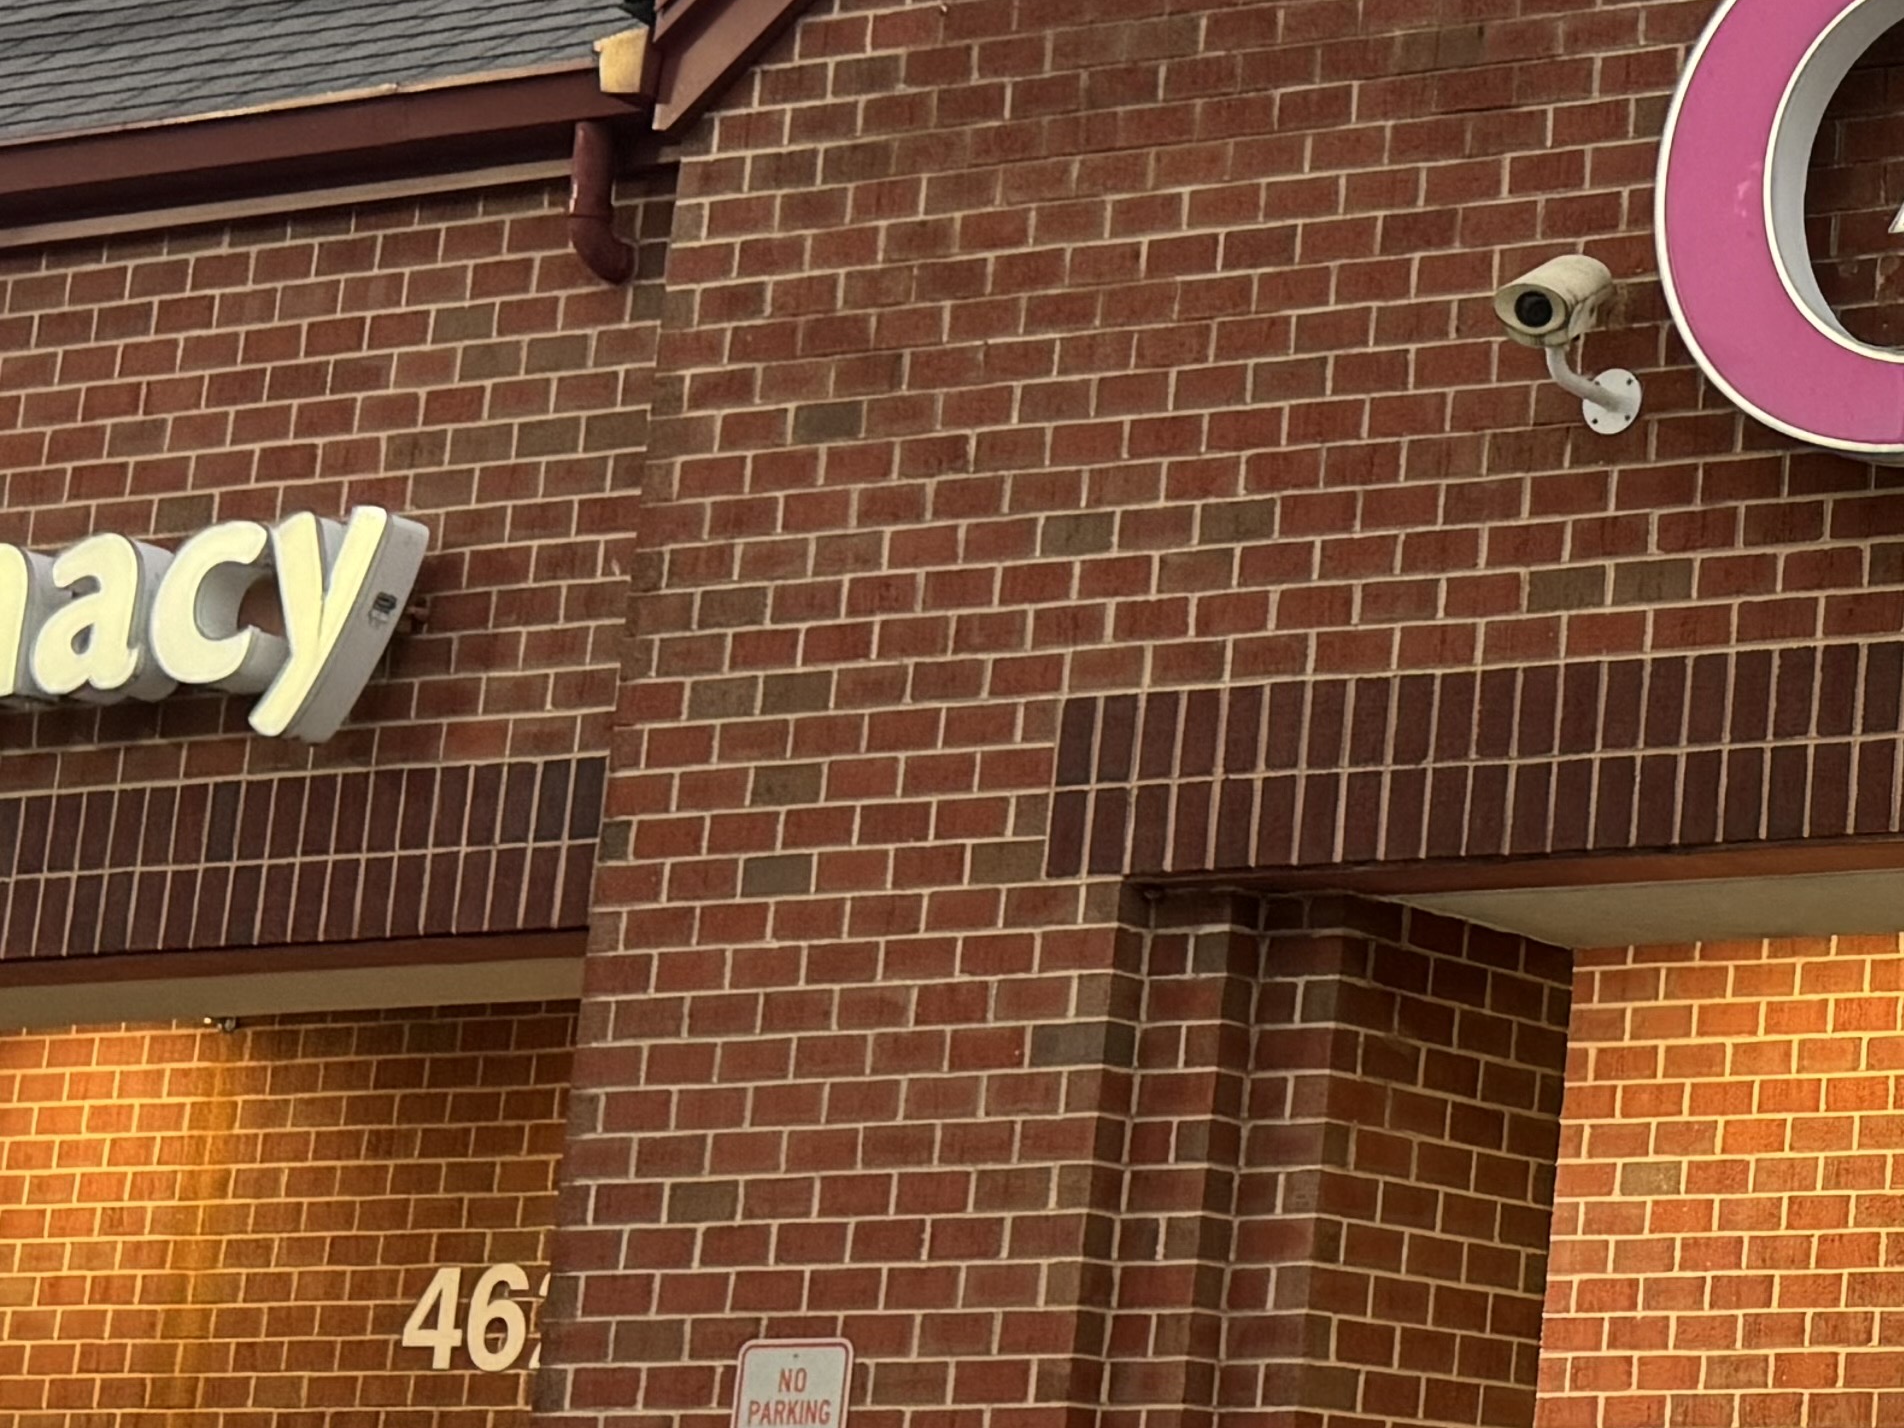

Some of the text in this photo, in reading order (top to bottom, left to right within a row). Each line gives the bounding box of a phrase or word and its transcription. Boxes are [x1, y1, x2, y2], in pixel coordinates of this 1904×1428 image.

[0, 506, 390, 738] acy
[778, 1368, 807, 1393] NO
[747, 1399, 831, 1426] PARKING
